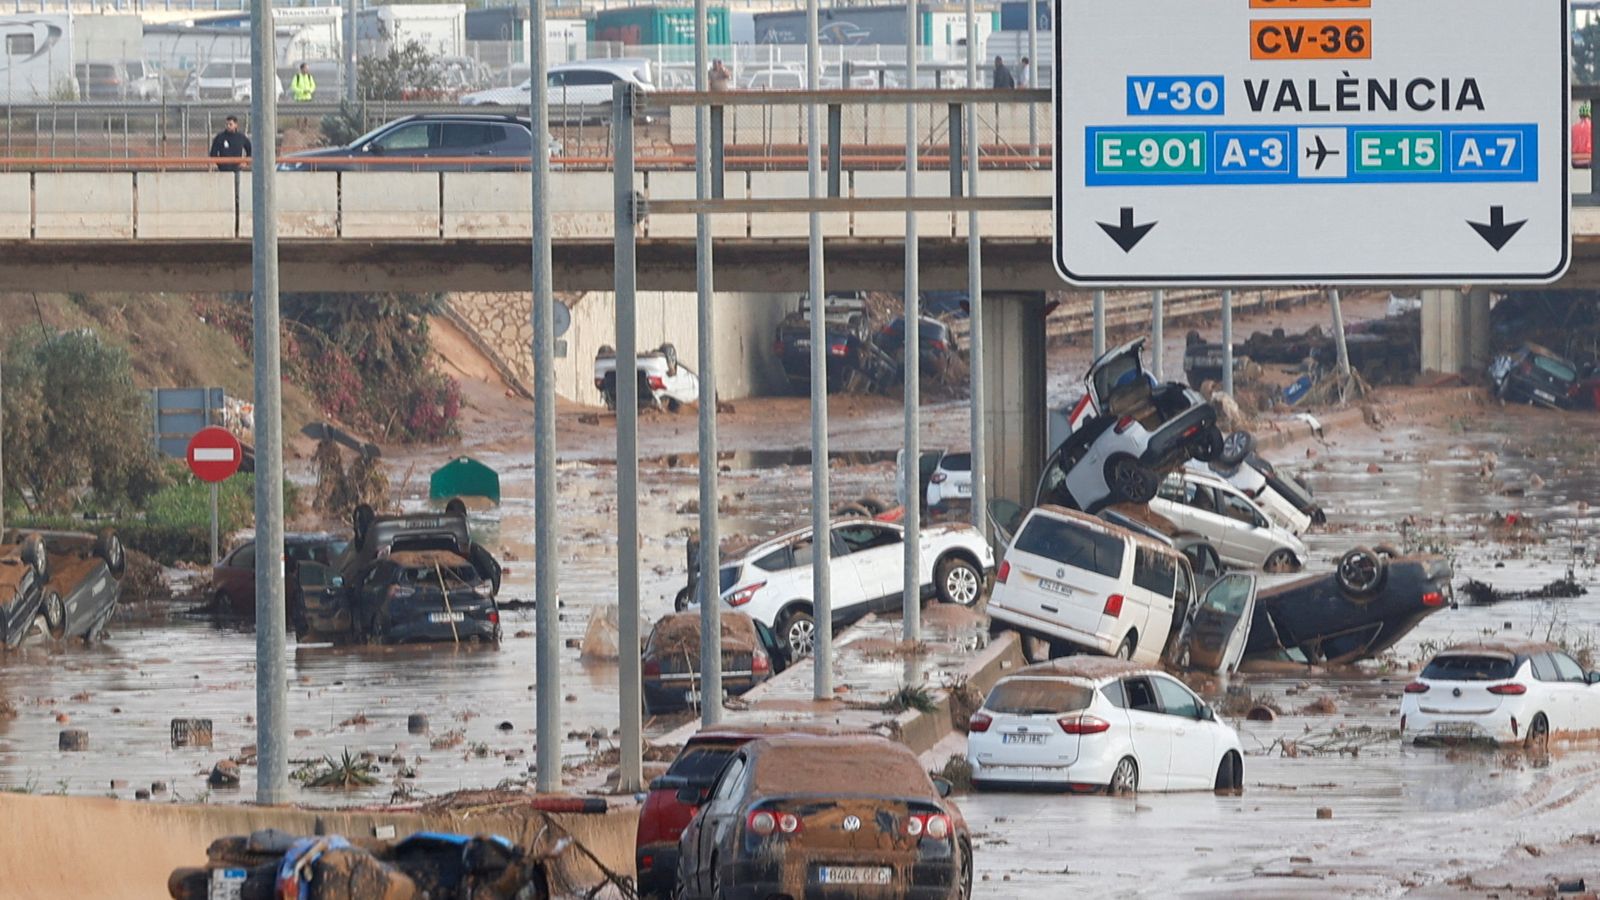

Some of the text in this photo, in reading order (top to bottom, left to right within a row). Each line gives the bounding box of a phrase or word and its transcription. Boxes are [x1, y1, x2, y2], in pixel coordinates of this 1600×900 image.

[1257, 26, 1365, 53] CV-36
[1134, 71, 1485, 112] V-30 VALÈNCIA
[1102, 137, 1516, 167] E-901 A-3 E-15 A-7
